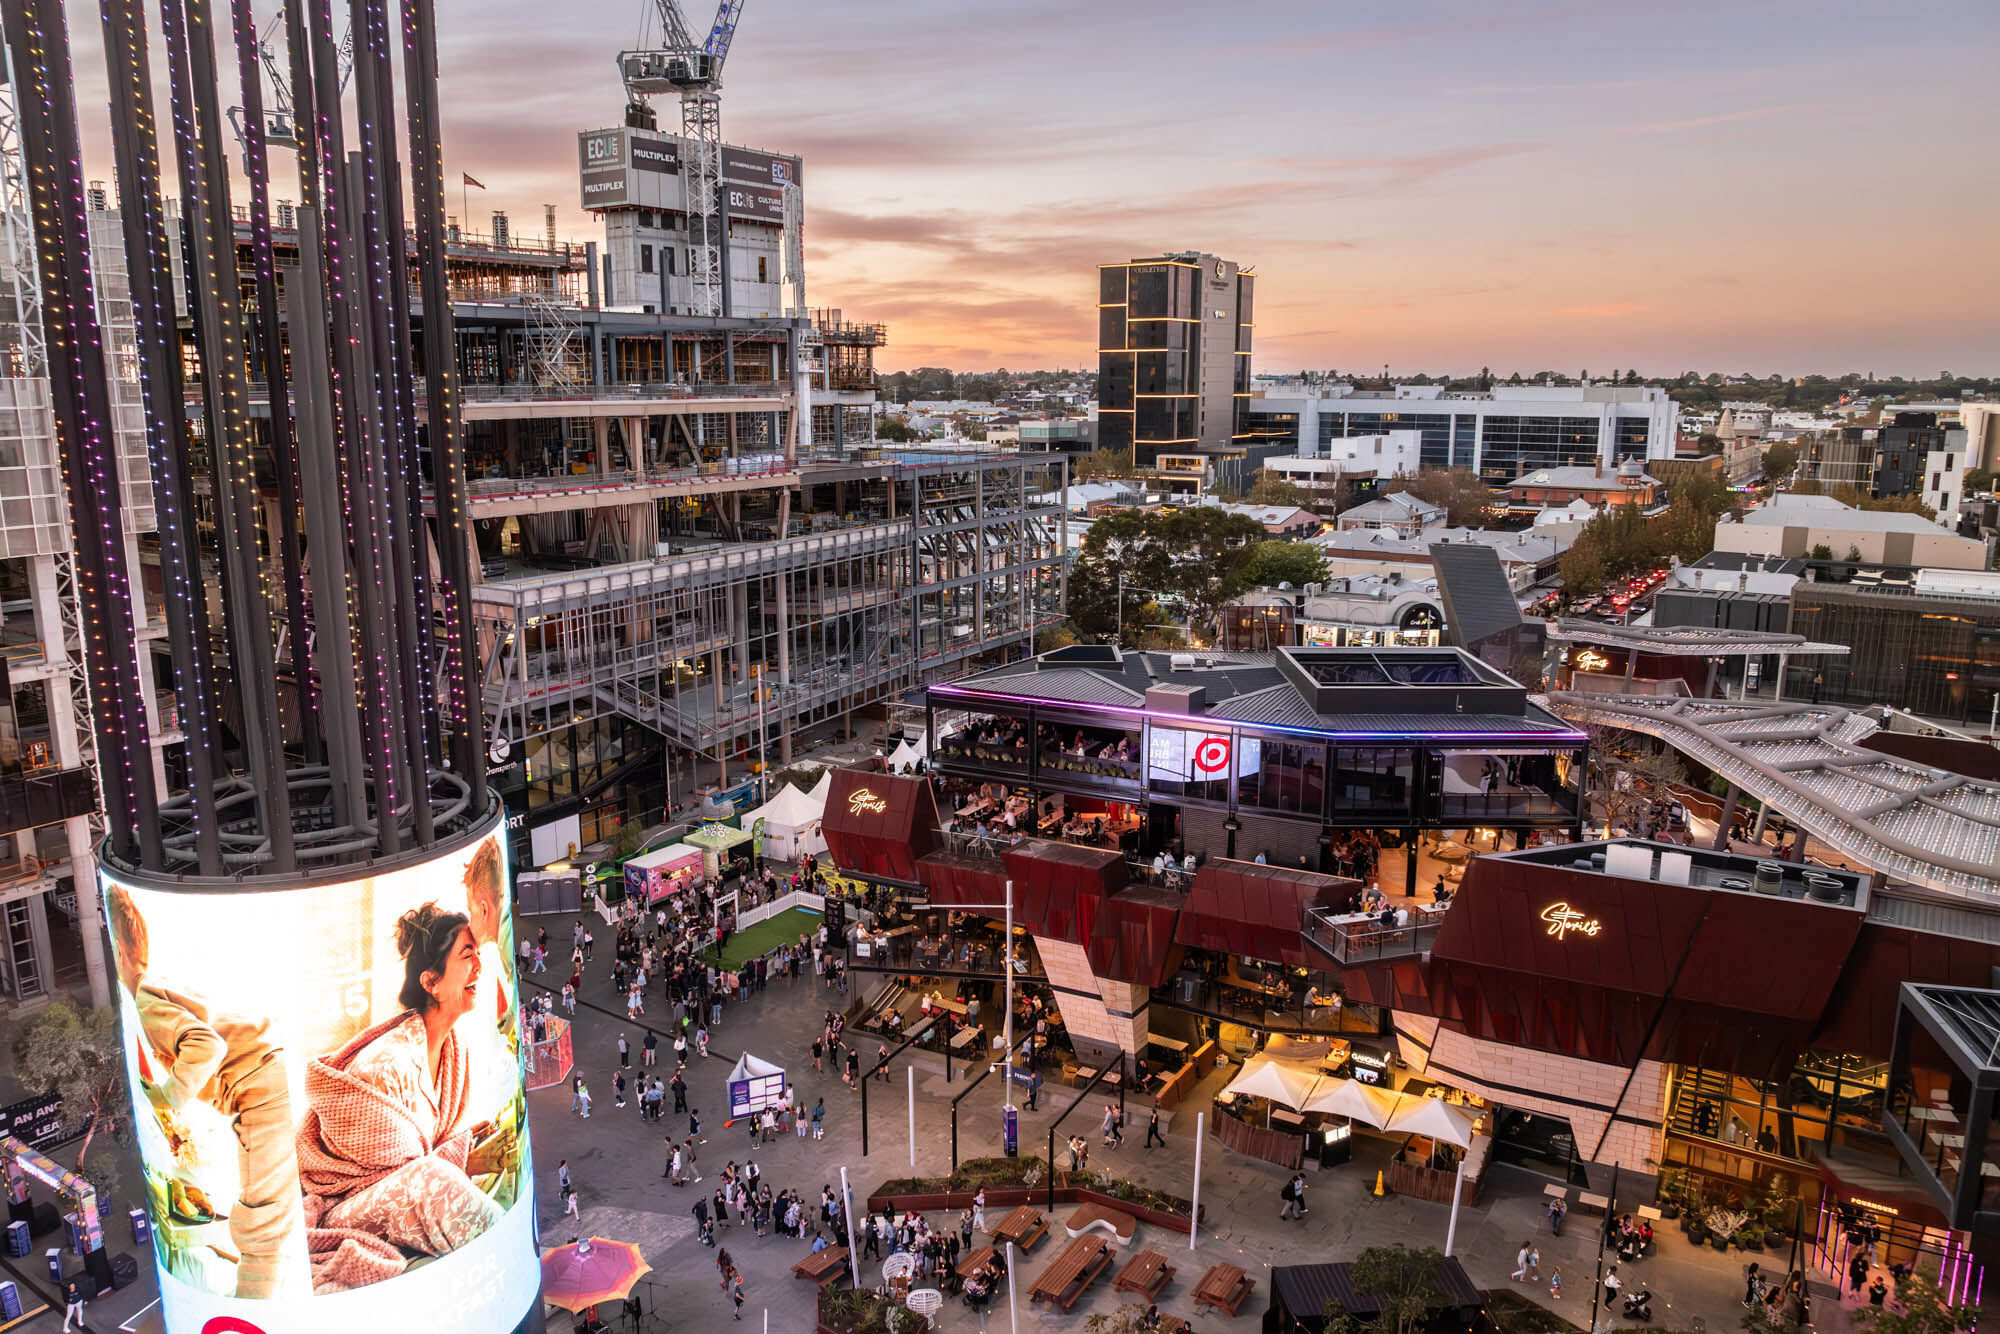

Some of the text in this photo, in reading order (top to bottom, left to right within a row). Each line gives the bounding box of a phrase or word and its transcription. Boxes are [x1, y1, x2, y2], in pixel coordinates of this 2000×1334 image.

[587, 137, 612, 159] ECU
[633, 148, 676, 163] MULTIPLEX
[772, 162, 789, 178] ECU
[584, 179, 625, 194] MULTIPLEX
[758, 196, 783, 207] CULTURE
[485, 761, 518, 776] transperth
[848, 788, 887, 817] Stories
[1541, 902, 1602, 940] Stories
[13, 1112, 33, 1127] AN
[1850, 1197, 1899, 1216] POURHOUSE
